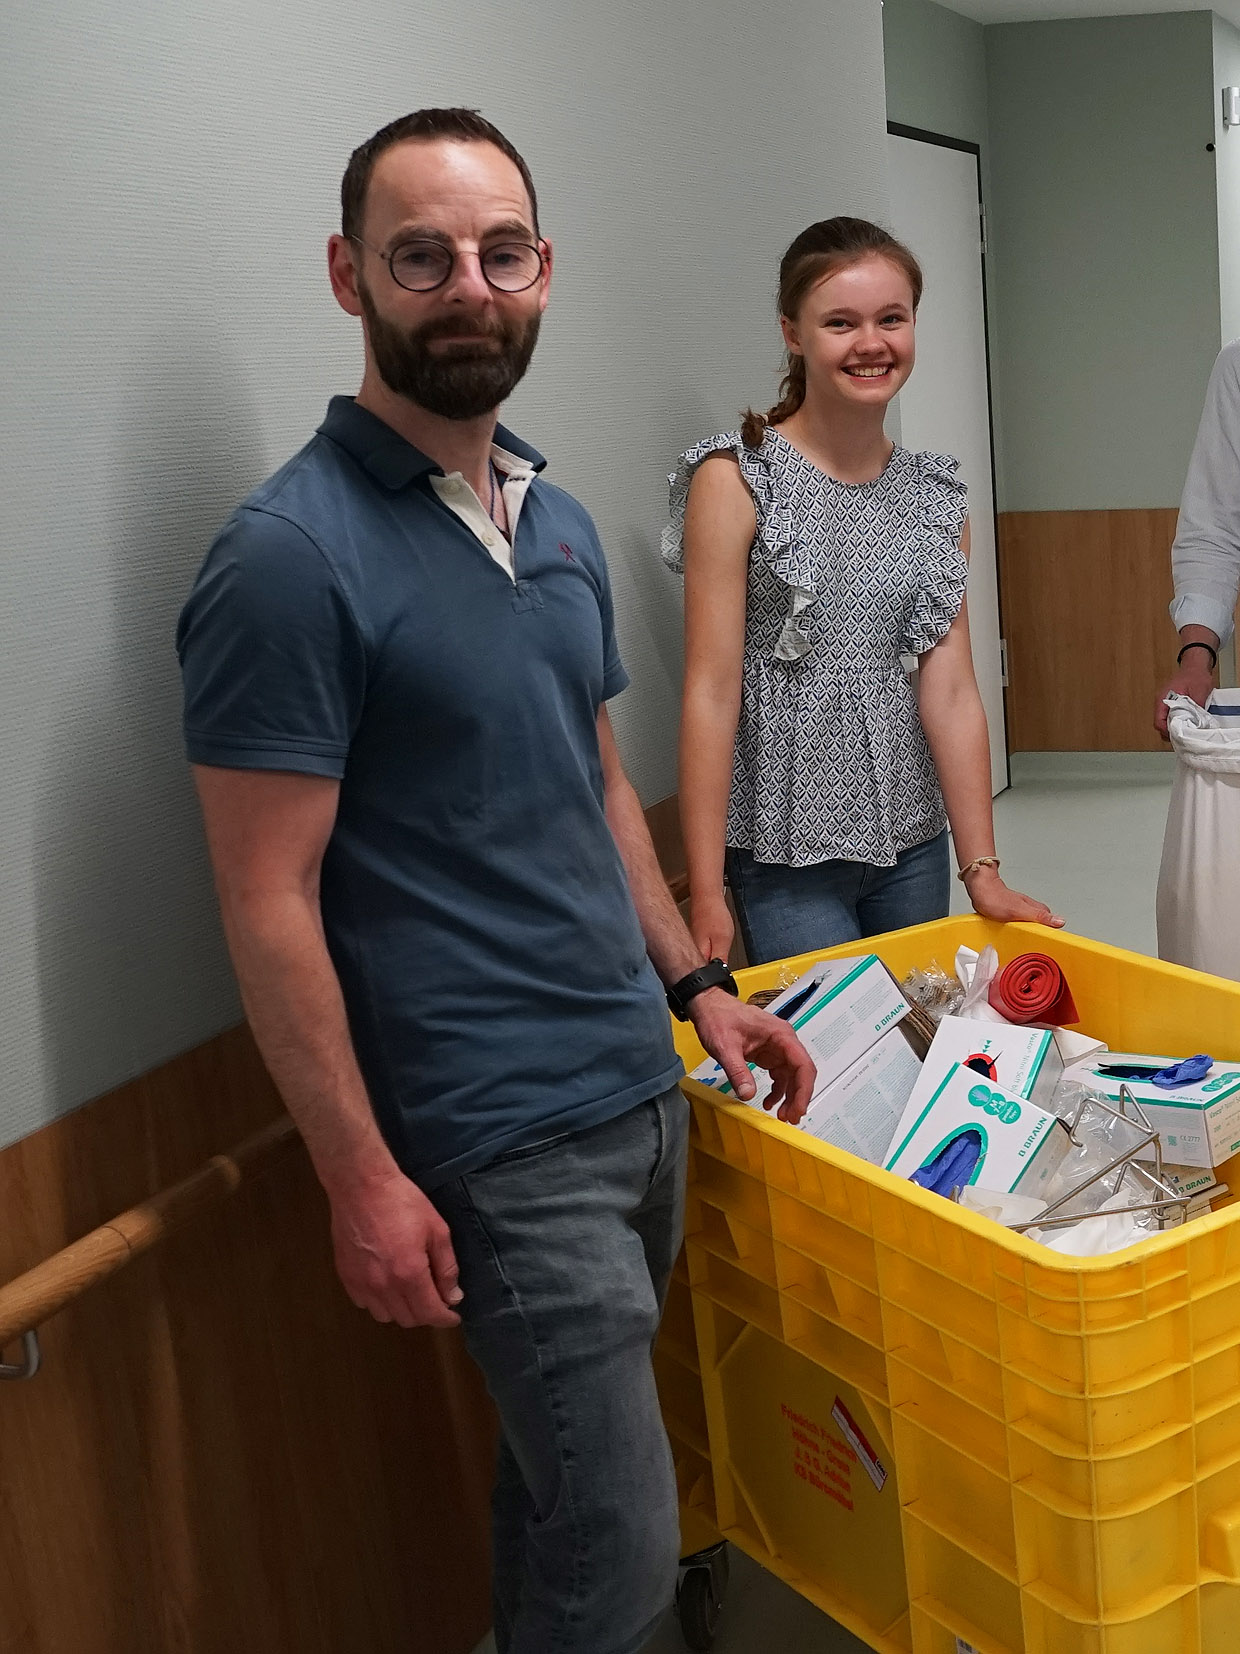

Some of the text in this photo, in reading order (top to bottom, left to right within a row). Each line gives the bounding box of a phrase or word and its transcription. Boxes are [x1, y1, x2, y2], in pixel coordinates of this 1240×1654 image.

[880, 1002, 905, 1026] BRAUN
[1024, 1116, 1048, 1149] BRAUN
[1186, 1176, 1212, 1190] BRAUN
